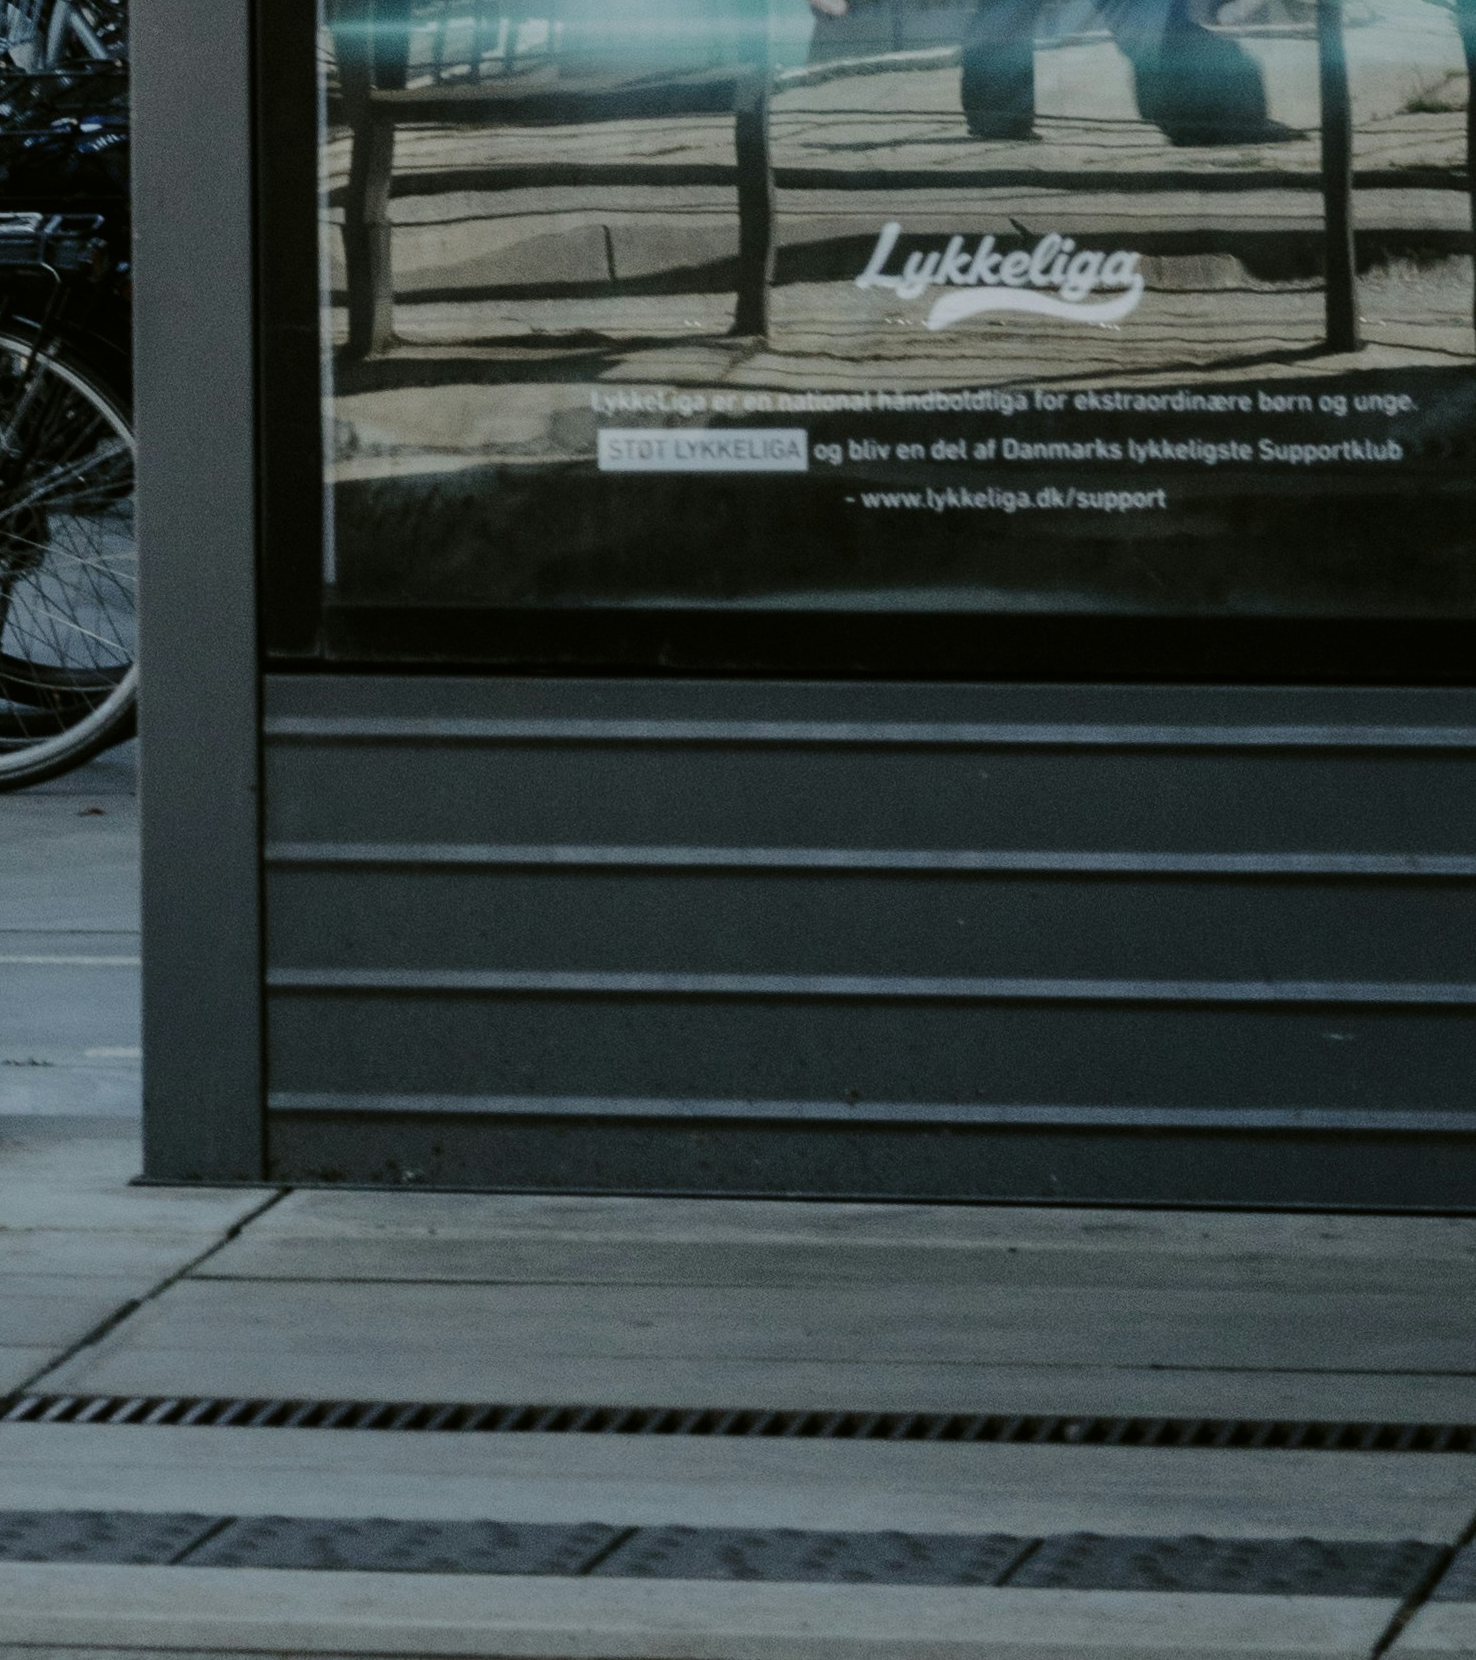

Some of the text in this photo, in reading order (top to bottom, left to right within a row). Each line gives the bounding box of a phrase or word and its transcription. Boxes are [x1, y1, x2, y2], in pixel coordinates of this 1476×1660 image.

[855, 222, 1140, 301] Lykkeliga
[712, 394, 736, 411] er
[744, 393, 772, 411] en
[779, 390, 872, 411] national
[1035, 390, 1065, 411] for
[1074, 389, 1253, 412] ekstraordinære
[1257, 391, 1313, 411] børn
[1318, 395, 1347, 416] og
[608, 436, 1403, 466] STØT LYKKELIGA og bliv en del af Danmarks lykkeligste Supportklub
[860, 487, 1167, 513] www.lykkeliga.dk/support
